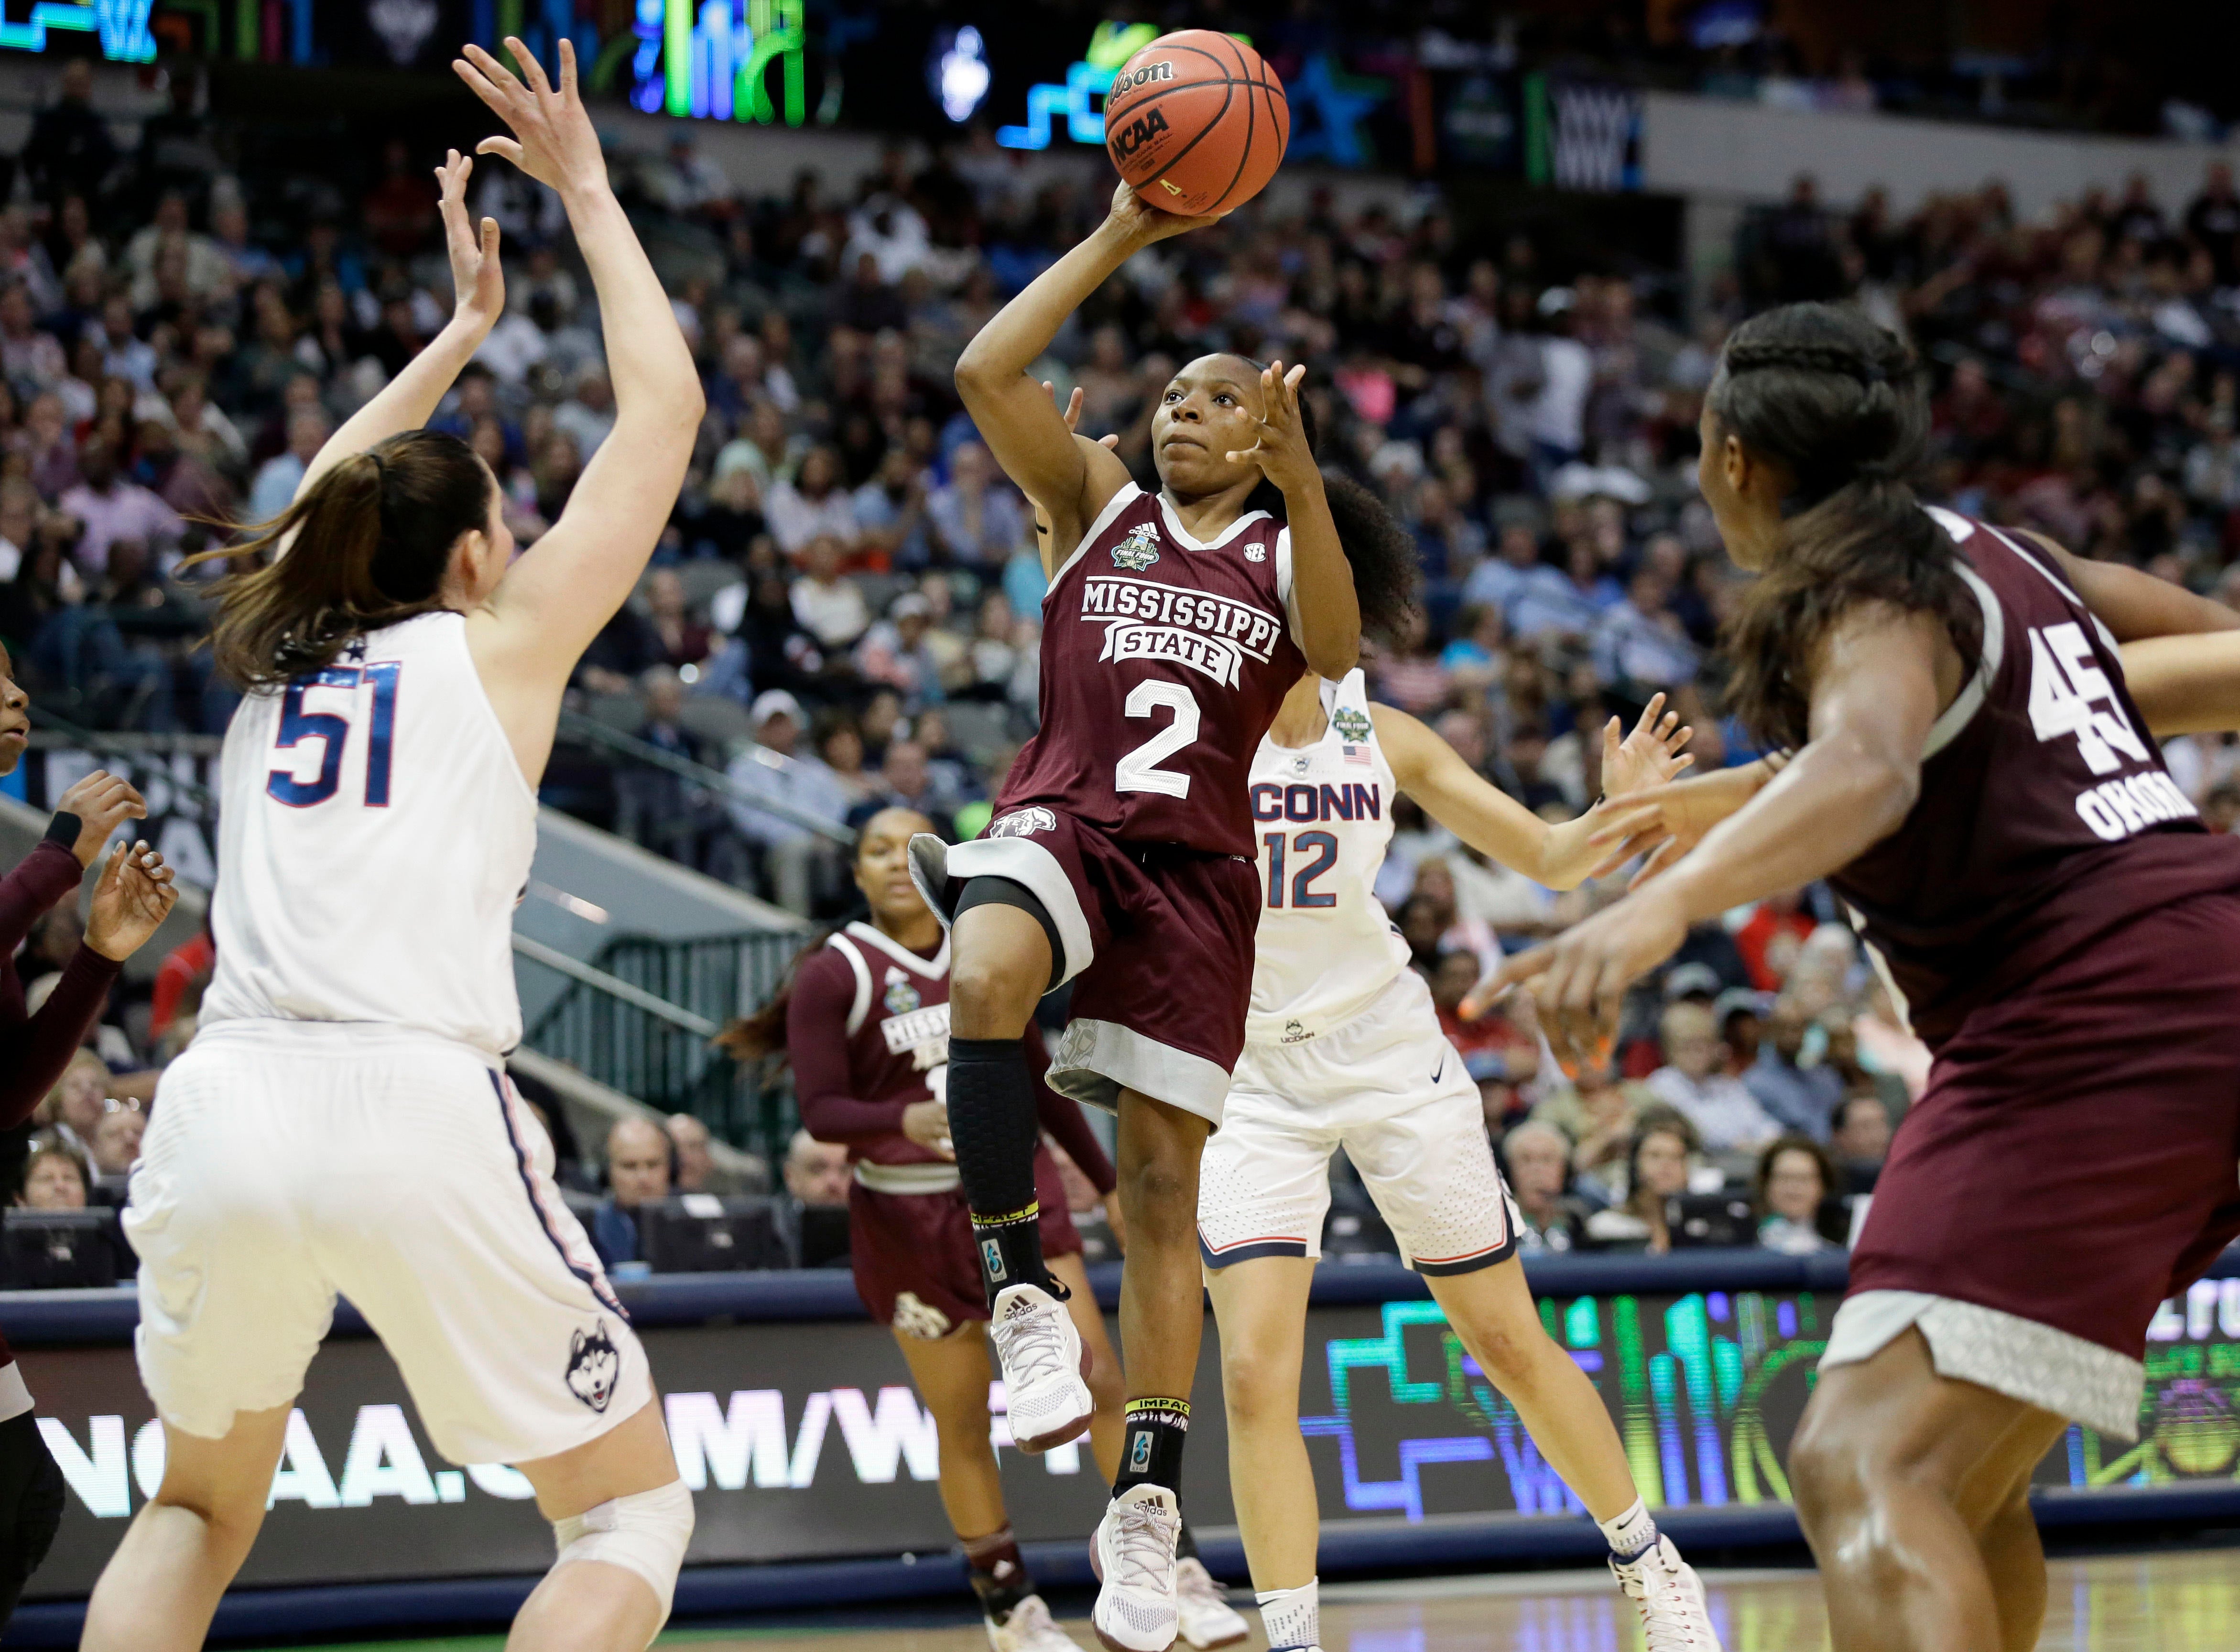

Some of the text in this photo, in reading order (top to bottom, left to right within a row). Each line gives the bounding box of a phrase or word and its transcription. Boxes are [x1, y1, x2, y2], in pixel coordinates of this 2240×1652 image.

[1111, 108, 1169, 166] NCAA
[1129, 529, 1161, 542] adidas
[1245, 544, 1265, 560] SEC
[1135, 552, 1154, 561] FOUR
[1082, 583, 1281, 656] MISSISSIPPI
[1123, 632, 1221, 673] STATE
[2028, 621, 2151, 776] 45
[266, 661, 402, 808] 51
[1115, 679, 1201, 799] 2
[1250, 783, 1380, 822] CONN
[1264, 831, 1337, 908] 12
[1004, 1303, 1037, 1319] adidas
[1140, 1400, 1189, 1413] IMPAC
[1134, 1503, 1167, 1516] adidas
